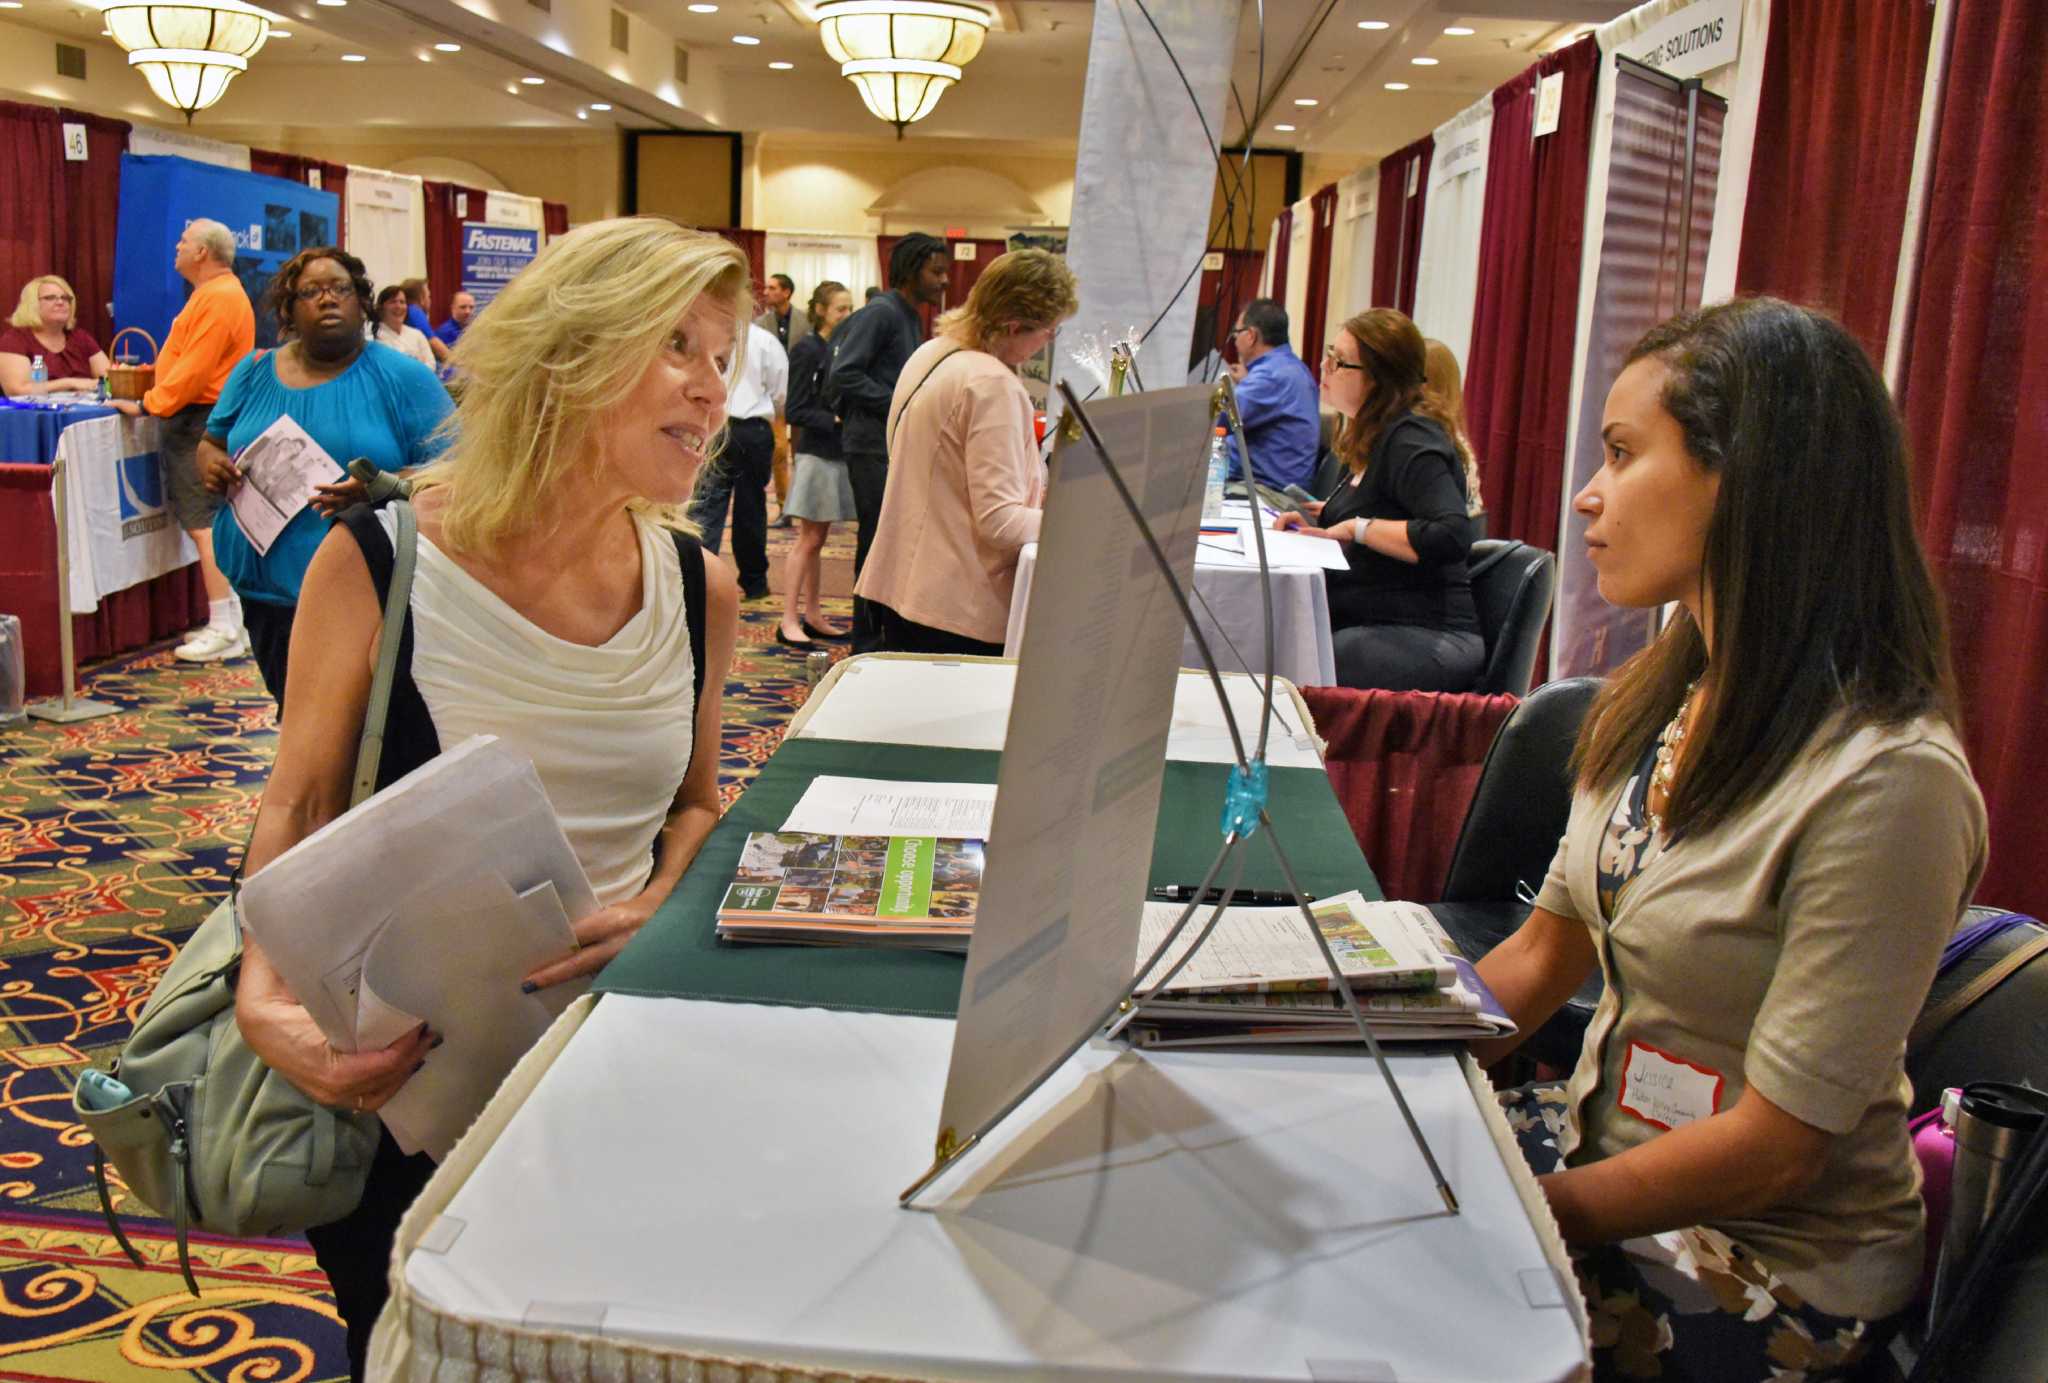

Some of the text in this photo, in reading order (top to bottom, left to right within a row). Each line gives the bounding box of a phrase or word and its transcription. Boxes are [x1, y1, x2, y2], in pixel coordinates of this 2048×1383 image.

[1666, 17, 1724, 62] SOLUTIONS
[69, 132, 83, 154] 46
[468, 229, 533, 252] FASTENAL
[901, 839, 923, 868] Choose
